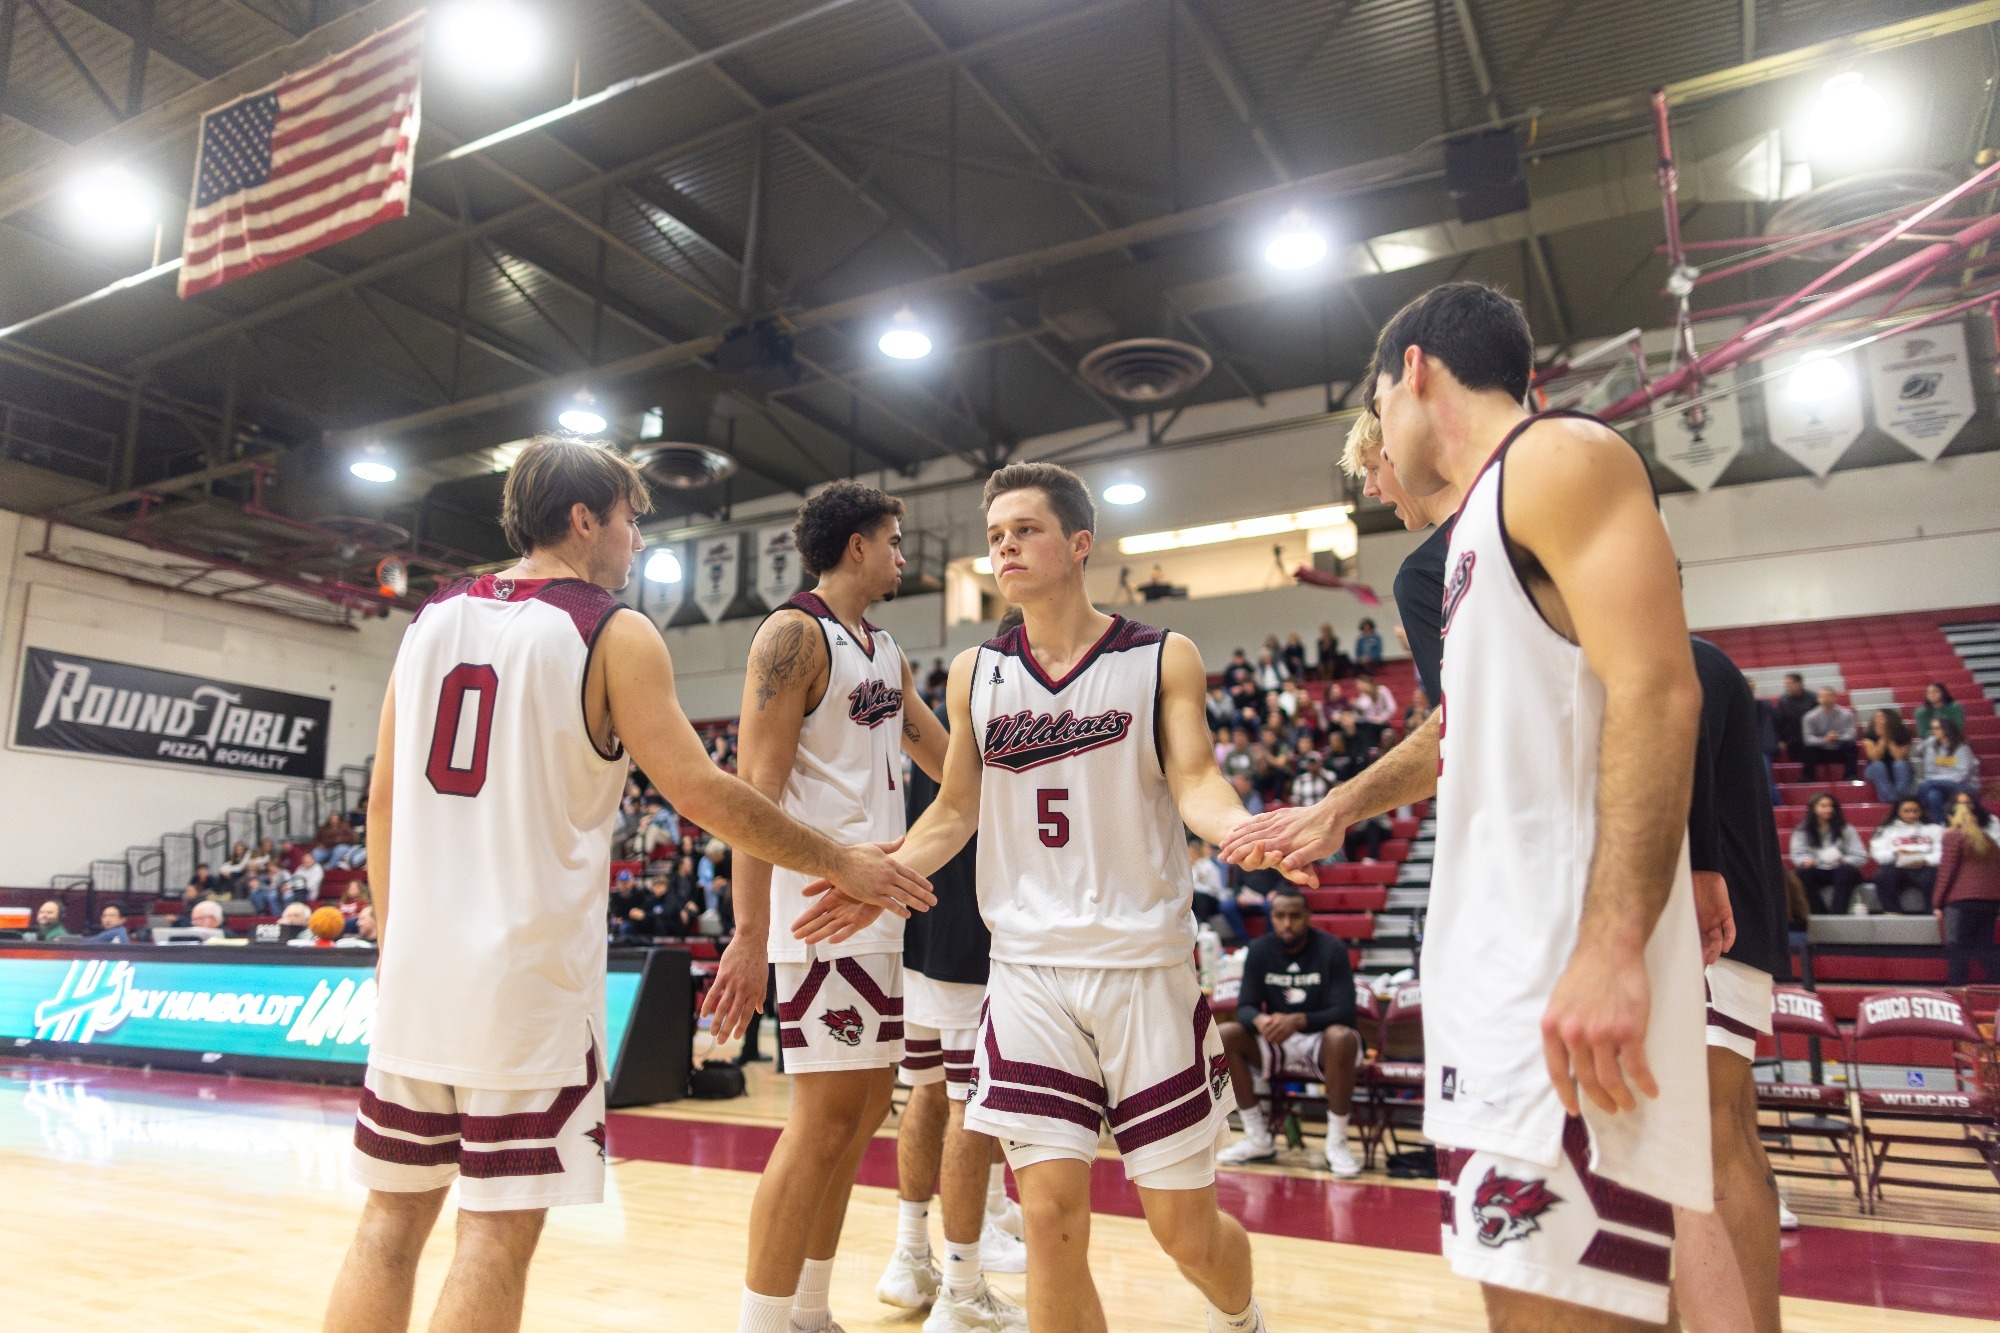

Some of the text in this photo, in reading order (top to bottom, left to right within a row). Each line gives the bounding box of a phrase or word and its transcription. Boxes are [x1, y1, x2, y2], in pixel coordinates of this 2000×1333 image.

[425, 661, 499, 798] 0
[983, 709, 1132, 766] Wildcats
[158, 739, 289, 771] PIZZA ROYALTY
[1036, 788, 1070, 848] 5
[158, 989, 305, 1027] HUMBOLDT
[1776, 993, 1824, 1022] STATE
[1864, 997, 1965, 1026] CHICO STATE
[1880, 1092, 1971, 1108] WILDCATS
